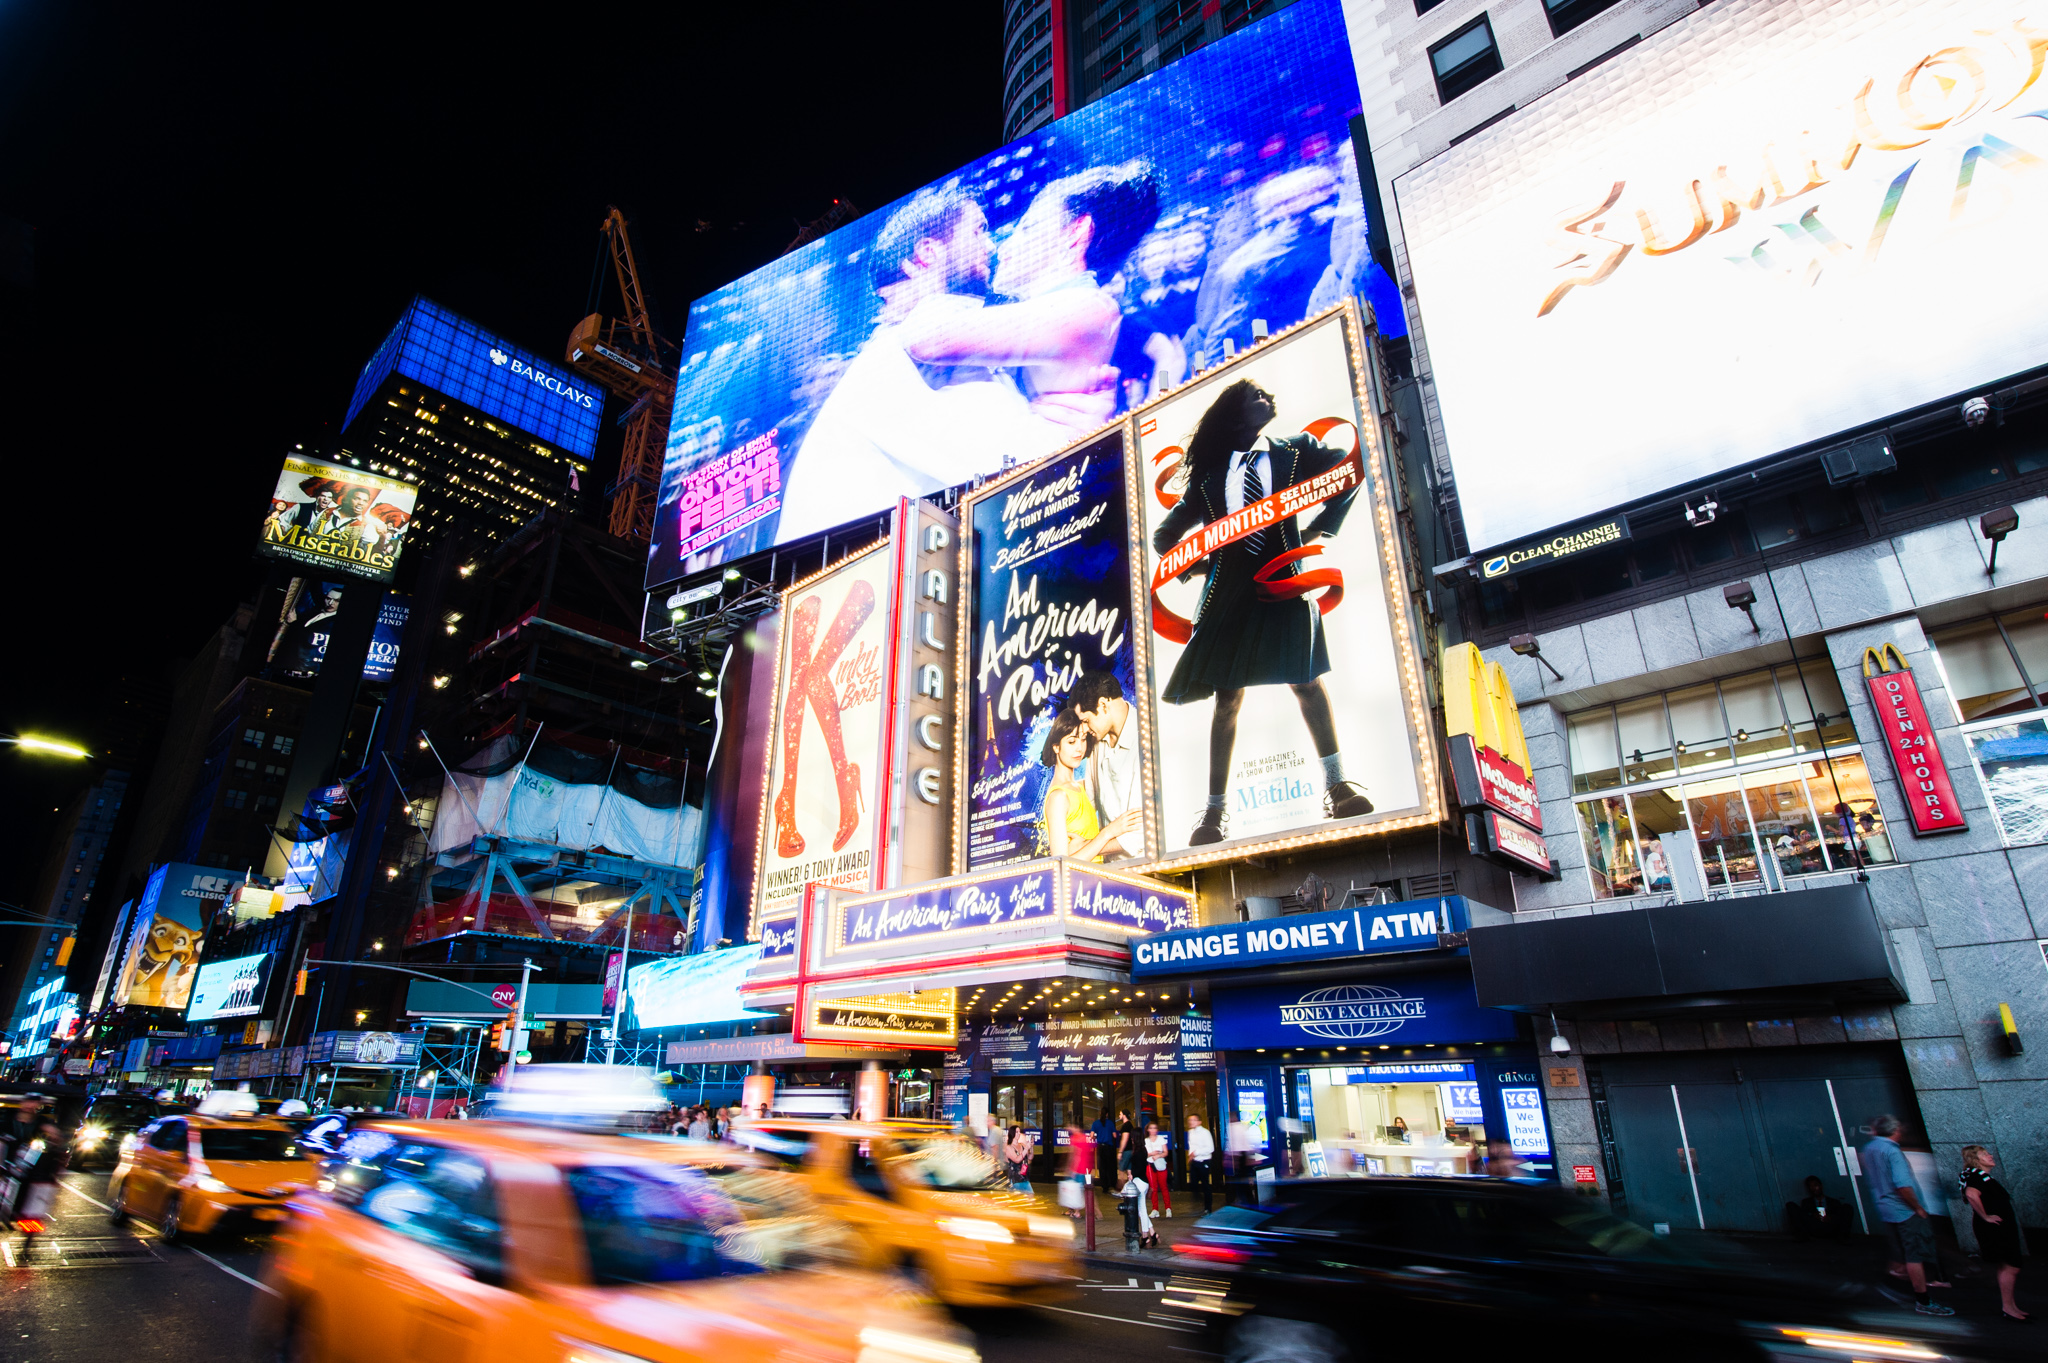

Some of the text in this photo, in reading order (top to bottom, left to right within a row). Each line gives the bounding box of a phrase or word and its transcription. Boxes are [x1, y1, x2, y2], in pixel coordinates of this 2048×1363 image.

[608, 352, 635, 369] MORROW
[511, 358, 593, 409] BARCLAYS
[682, 428, 778, 486] THE STORY OF EMILIO
[696, 464, 729, 486] GLORIA
[731, 439, 771, 466] ESTEFAN
[680, 446, 779, 511] ON YOUR
[1002, 455, 1090, 522] Winner!
[1280, 462, 1355, 503] SEE IT BEFORE
[680, 462, 781, 540] FEET!
[1004, 492, 1080, 540] 4 TONY AWARDS
[316, 519, 349, 541] Les
[680, 497, 780, 556] A NEW MUSICAL
[990, 536, 1032, 573] Best
[1034, 501, 1107, 552] Musical!
[1159, 473, 1357, 579] FINAL MONTHS JANUARY 1
[264, 518, 395, 569] Misérables
[1552, 531, 1621, 558] SPECTACOLOR
[320, 556, 350, 568] IMPERIAL
[351, 563, 381, 575] THEATRE
[1002, 569, 1040, 633] An
[977, 598, 1124, 694] American
[914, 523, 950, 806] PALACE
[1243, 750, 1297, 769] TIME MAGAZINE'S
[1885, 681, 1945, 820] OPEN 24 HOURS
[1246, 766, 1263, 778] SHOW
[1265, 765, 1273, 773] OF
[1275, 761, 1287, 770] THE
[1289, 758, 1305, 768] YEAR
[1480, 759, 1539, 809] McDonald's
[1236, 777, 1315, 812] Matilda
[191, 875, 229, 892] ICE
[767, 865, 803, 889] WINNER!
[812, 857, 835, 878] TONY
[765, 884, 804, 900] INCLUDING
[1073, 880, 1091, 910] An
[1092, 880, 1145, 928] American
[1145, 896, 1173, 932] Paris
[850, 908, 873, 942] An
[875, 900, 951, 941] American
[957, 886, 1003, 924] Paris
[1136, 910, 1438, 964] CHANGE MONEY ATM
[492, 991, 516, 1001] CNY
[1281, 1001, 1426, 1022] MONEY EXCHANGE
[1034, 1015, 1180, 1031] THE MOST AWARD-WINNING MUSICAL OF THE SEASON
[1180, 1018, 1212, 1032] CHANGE
[774, 1038, 786, 1047] BY
[774, 1046, 802, 1054] HILTON
[1037, 1033, 1073, 1049] Winner!
[1072, 1033, 1083, 1048] 4
[1087, 1035, 1108, 1047] 2015
[1111, 1032, 1135, 1050] Tony
[1135, 1030, 1179, 1046] Awards!
[1181, 1034, 1213, 1047] MONEY
[1235, 1079, 1264, 1087] CHANGE
[1498, 1073, 1538, 1083] CHANGE
[1514, 1125, 1540, 1134] have
[1516, 1112, 1534, 1121] We
[1513, 1138, 1546, 1147] CASH!
